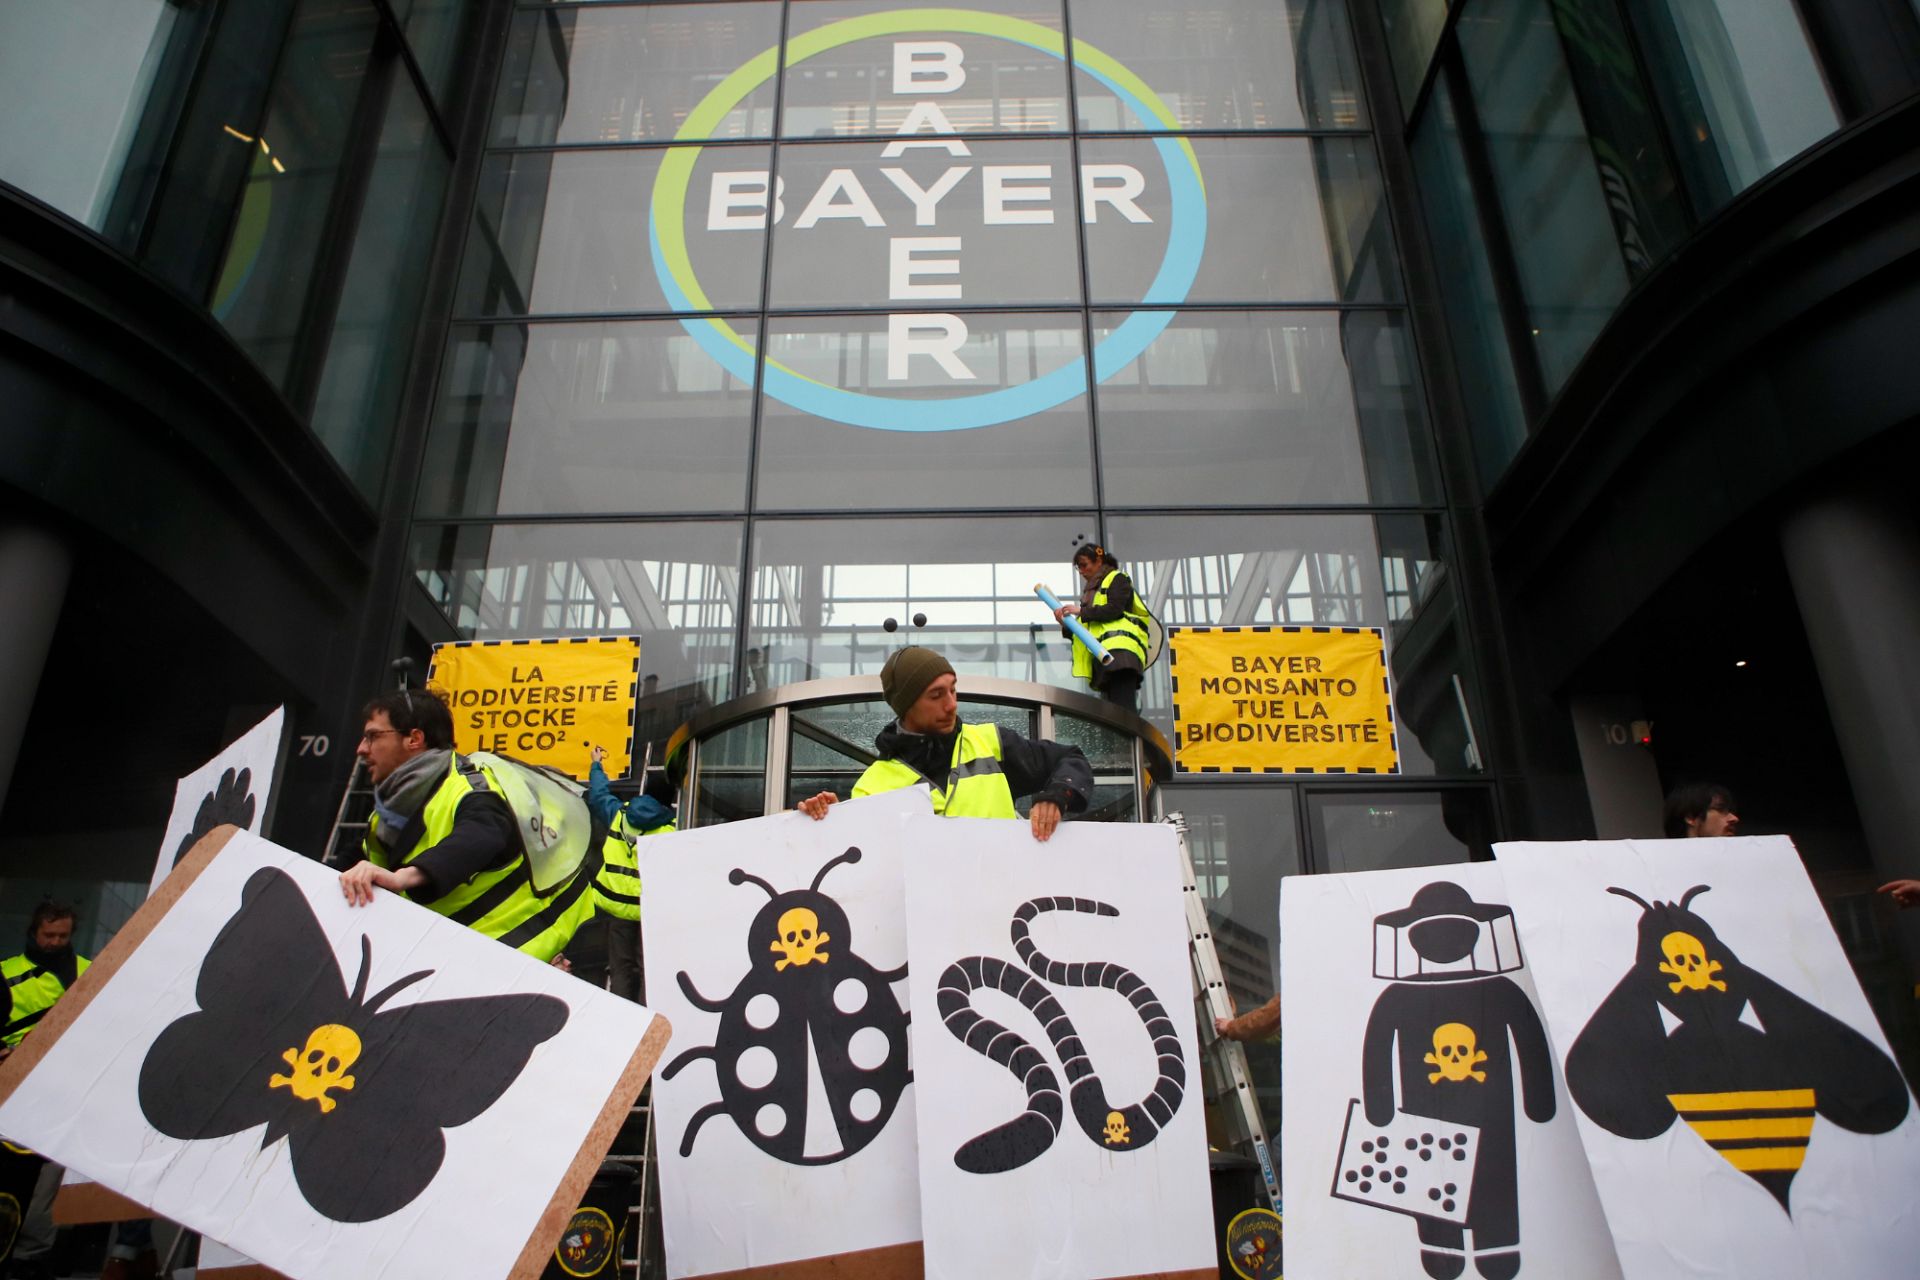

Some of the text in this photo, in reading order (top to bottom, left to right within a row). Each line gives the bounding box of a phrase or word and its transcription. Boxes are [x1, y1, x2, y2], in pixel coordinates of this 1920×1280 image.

[707, 164, 1154, 231] BAYER
[880, 41, 977, 381] BAYER
[511, 666, 544, 683] LA
[1231, 656, 1322, 673] BAYER
[1200, 677, 1357, 697] MONSANTO
[470, 708, 576, 729] STOCKE
[1232, 700, 1329, 719] TUE LA
[1187, 718, 1379, 743] BIODIVERSITÉ
[299, 735, 329, 757] 70
[478, 734, 508, 752] LE
